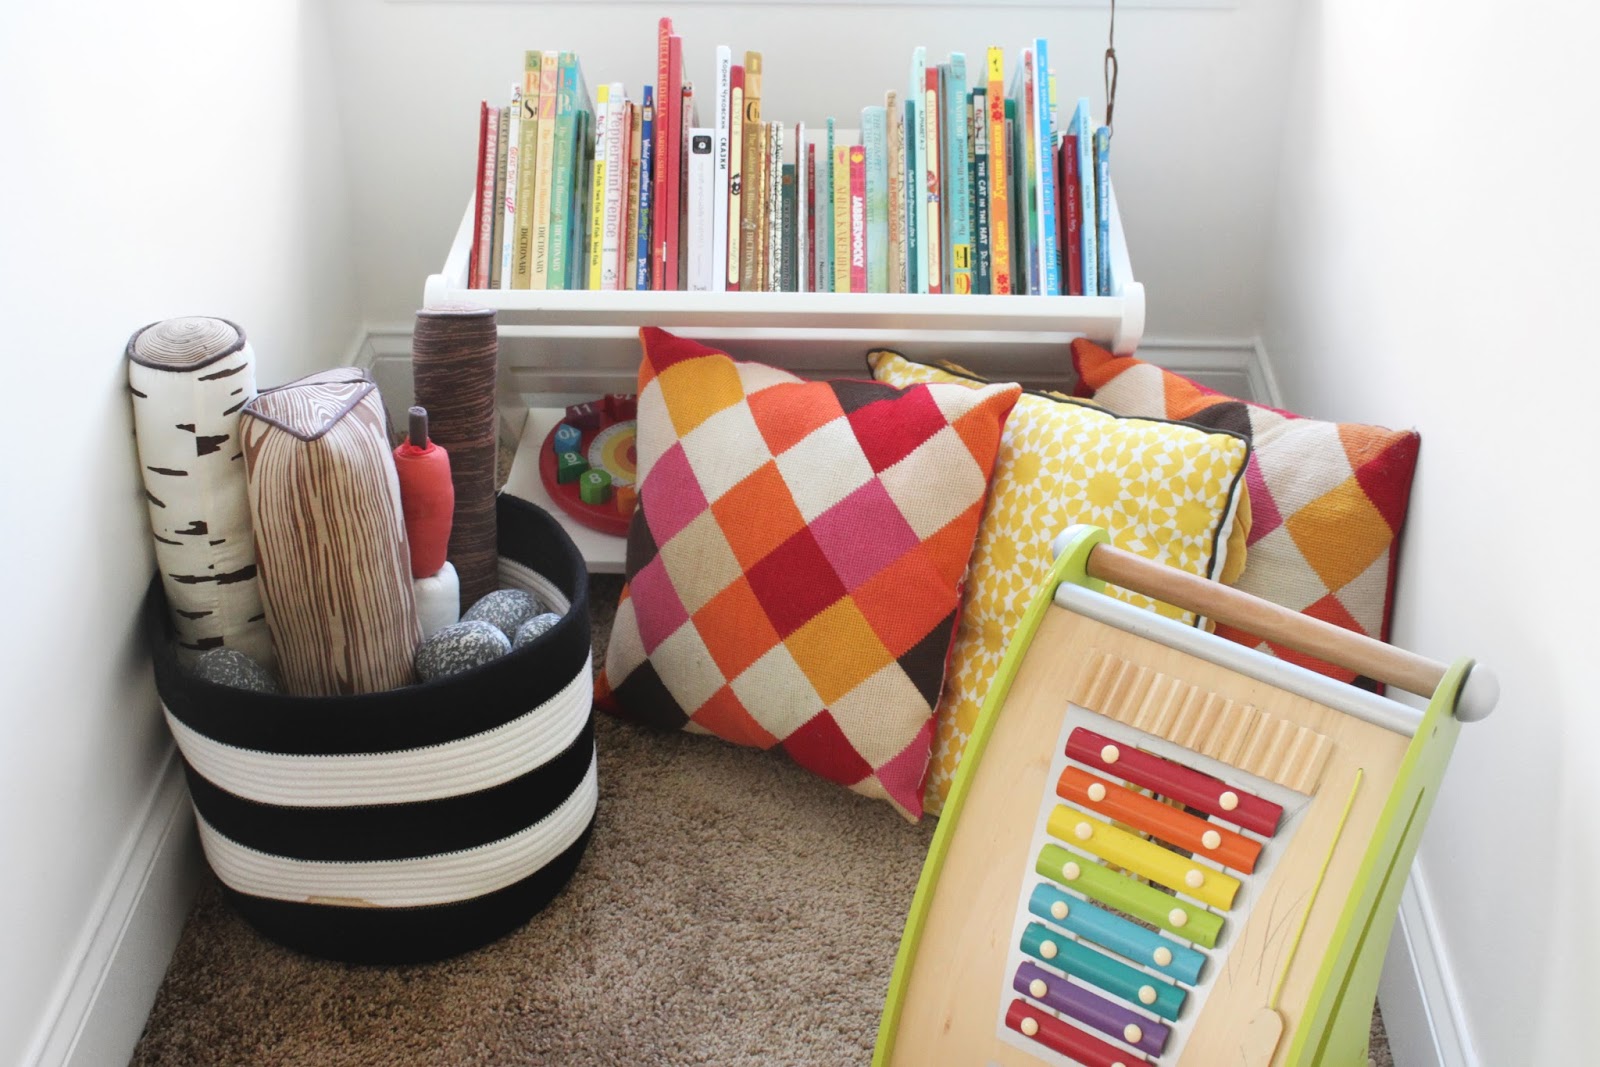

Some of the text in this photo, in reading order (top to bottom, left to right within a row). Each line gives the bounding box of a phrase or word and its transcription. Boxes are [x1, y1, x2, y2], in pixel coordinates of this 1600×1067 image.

[657, 27, 669, 118] AMELIA BEDELIA
[489, 115, 497, 132] MY
[484, 135, 496, 187] FATHER'S
[608, 111, 623, 194] Peppermint
[719, 137, 727, 170] СКАЗКИ
[481, 191, 493, 241] DRAGON
[505, 197, 515, 214] UP
[605, 198, 619, 239] Fence
[977, 161, 987, 246] THE CAT IN THE HAT
[518, 227, 529, 276] DICTIONARY
[536, 227, 547, 275] DICTIONARY
[744, 231, 755, 279] DICTIONARY
[852, 195, 864, 268] JABBERWOCKY
[572, 403, 592, 416] 11
[588, 473, 602, 484] 8
